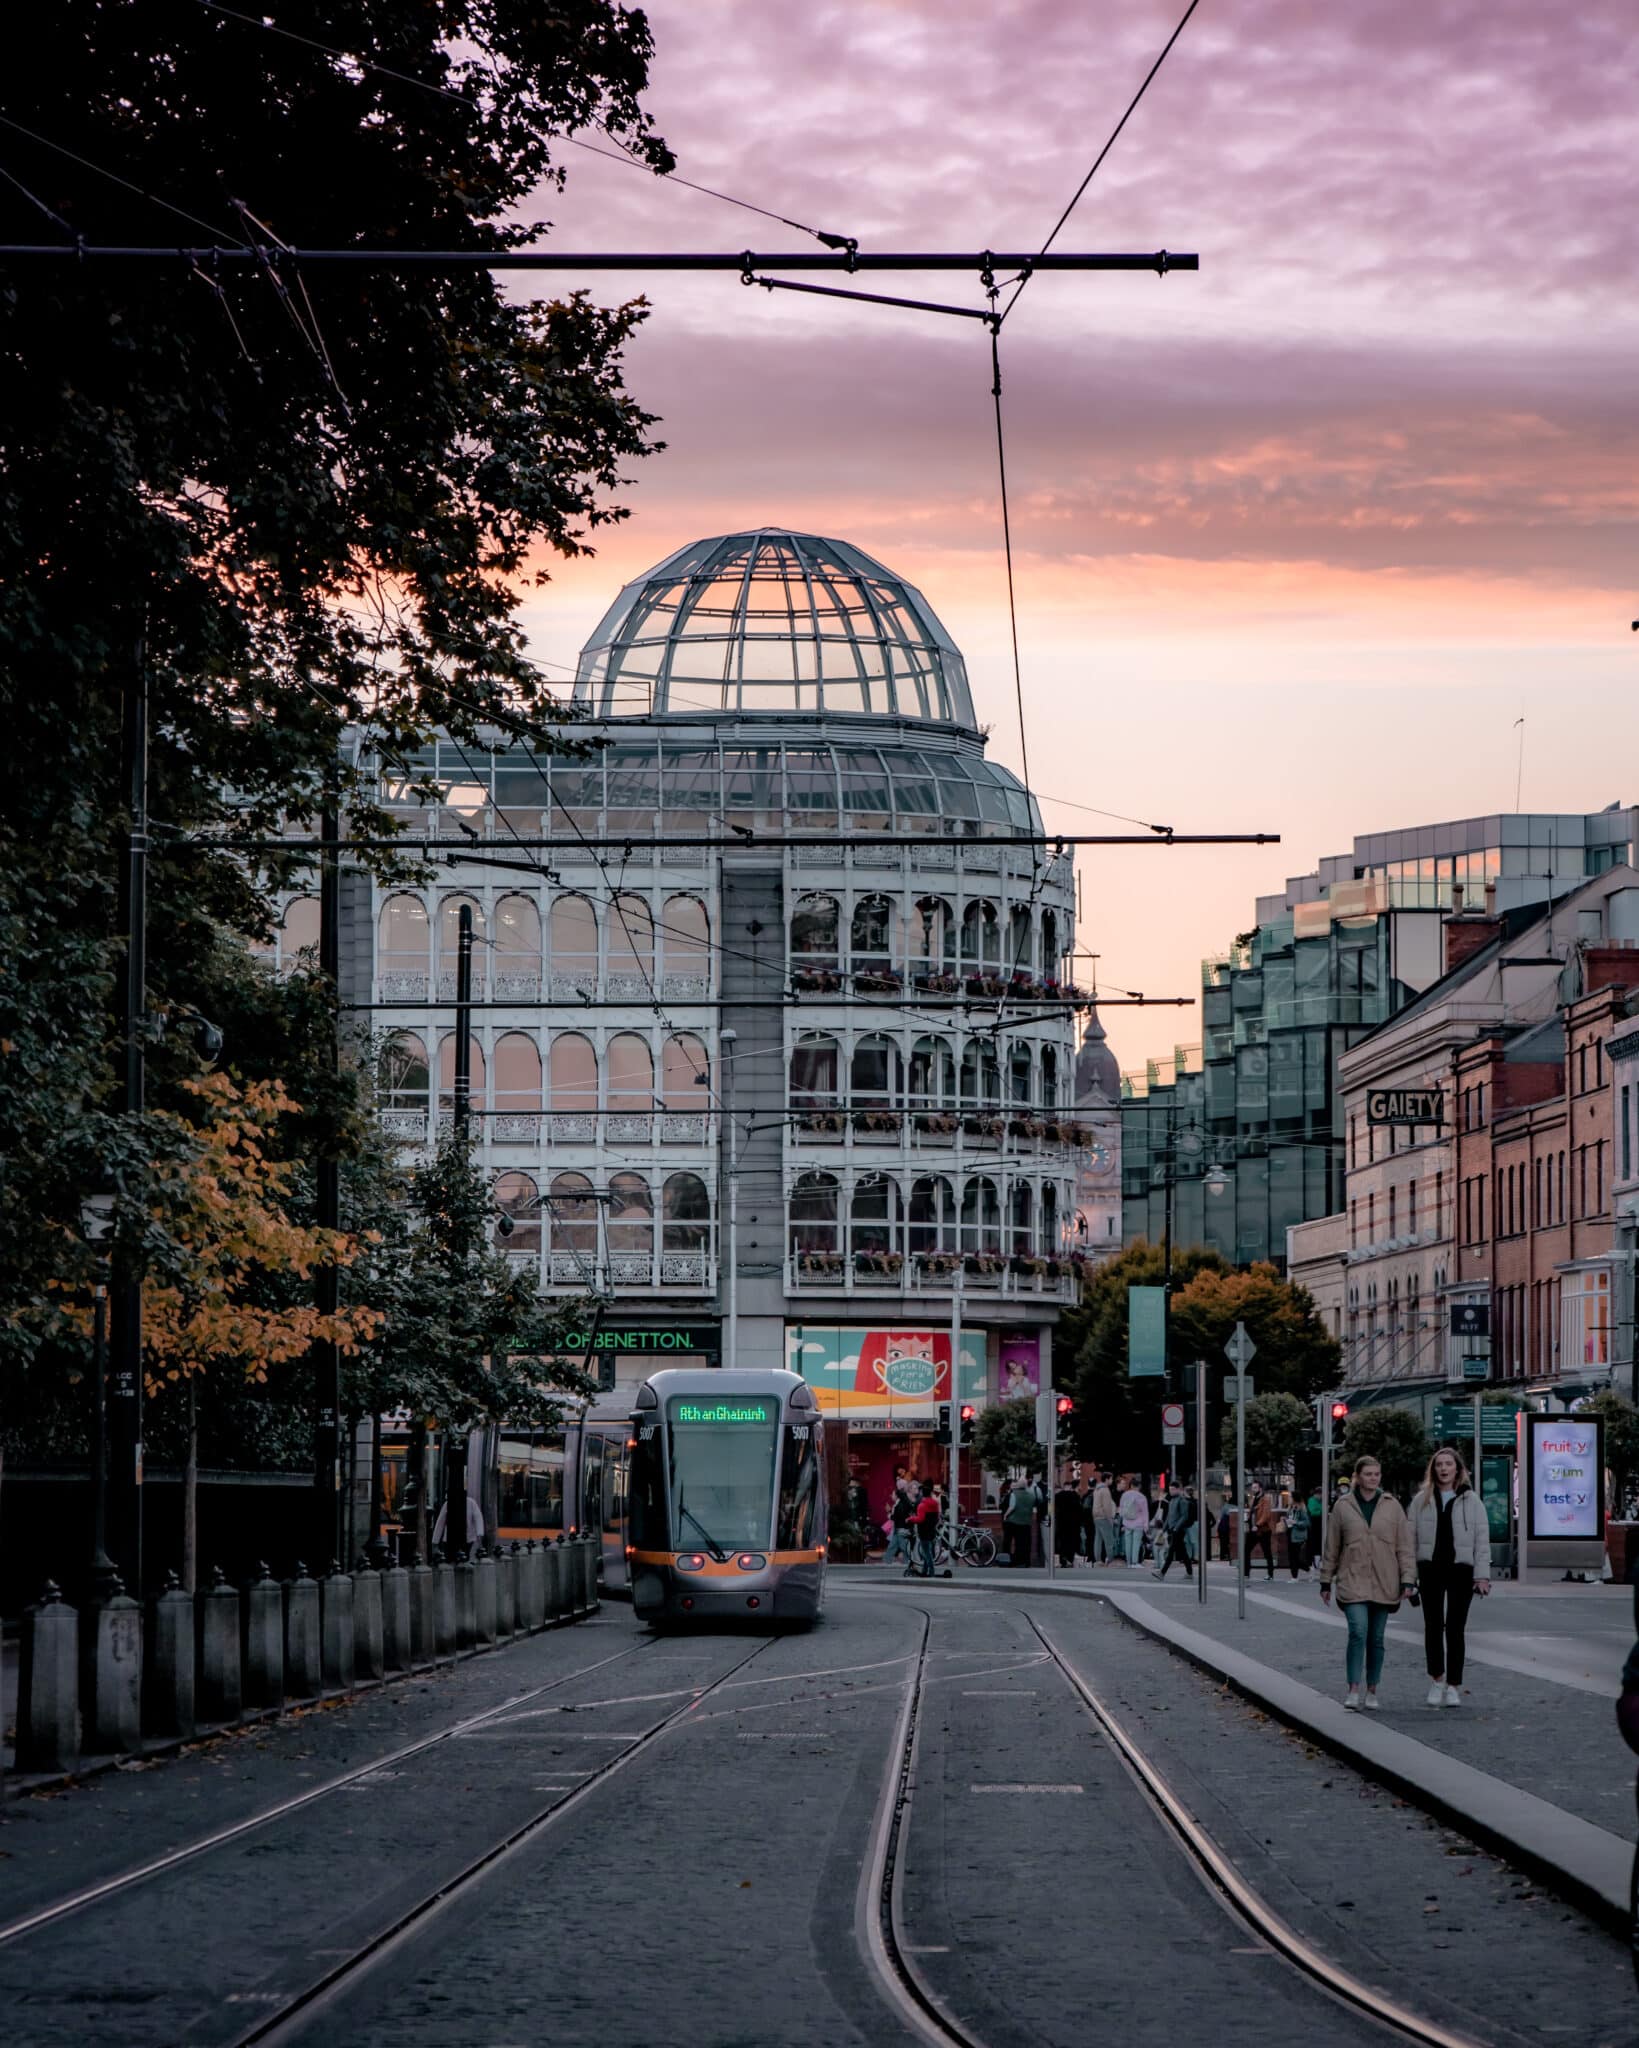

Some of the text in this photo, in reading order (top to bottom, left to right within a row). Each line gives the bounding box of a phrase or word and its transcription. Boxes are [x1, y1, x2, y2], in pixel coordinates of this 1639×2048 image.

[1370, 1092, 1442, 1120] GAIETY
[565, 1332, 591, 1348] OF
[703, 1410, 716, 1420] an
[638, 1426, 655, 1441] 5007
[792, 1426, 809, 1440] 5007
